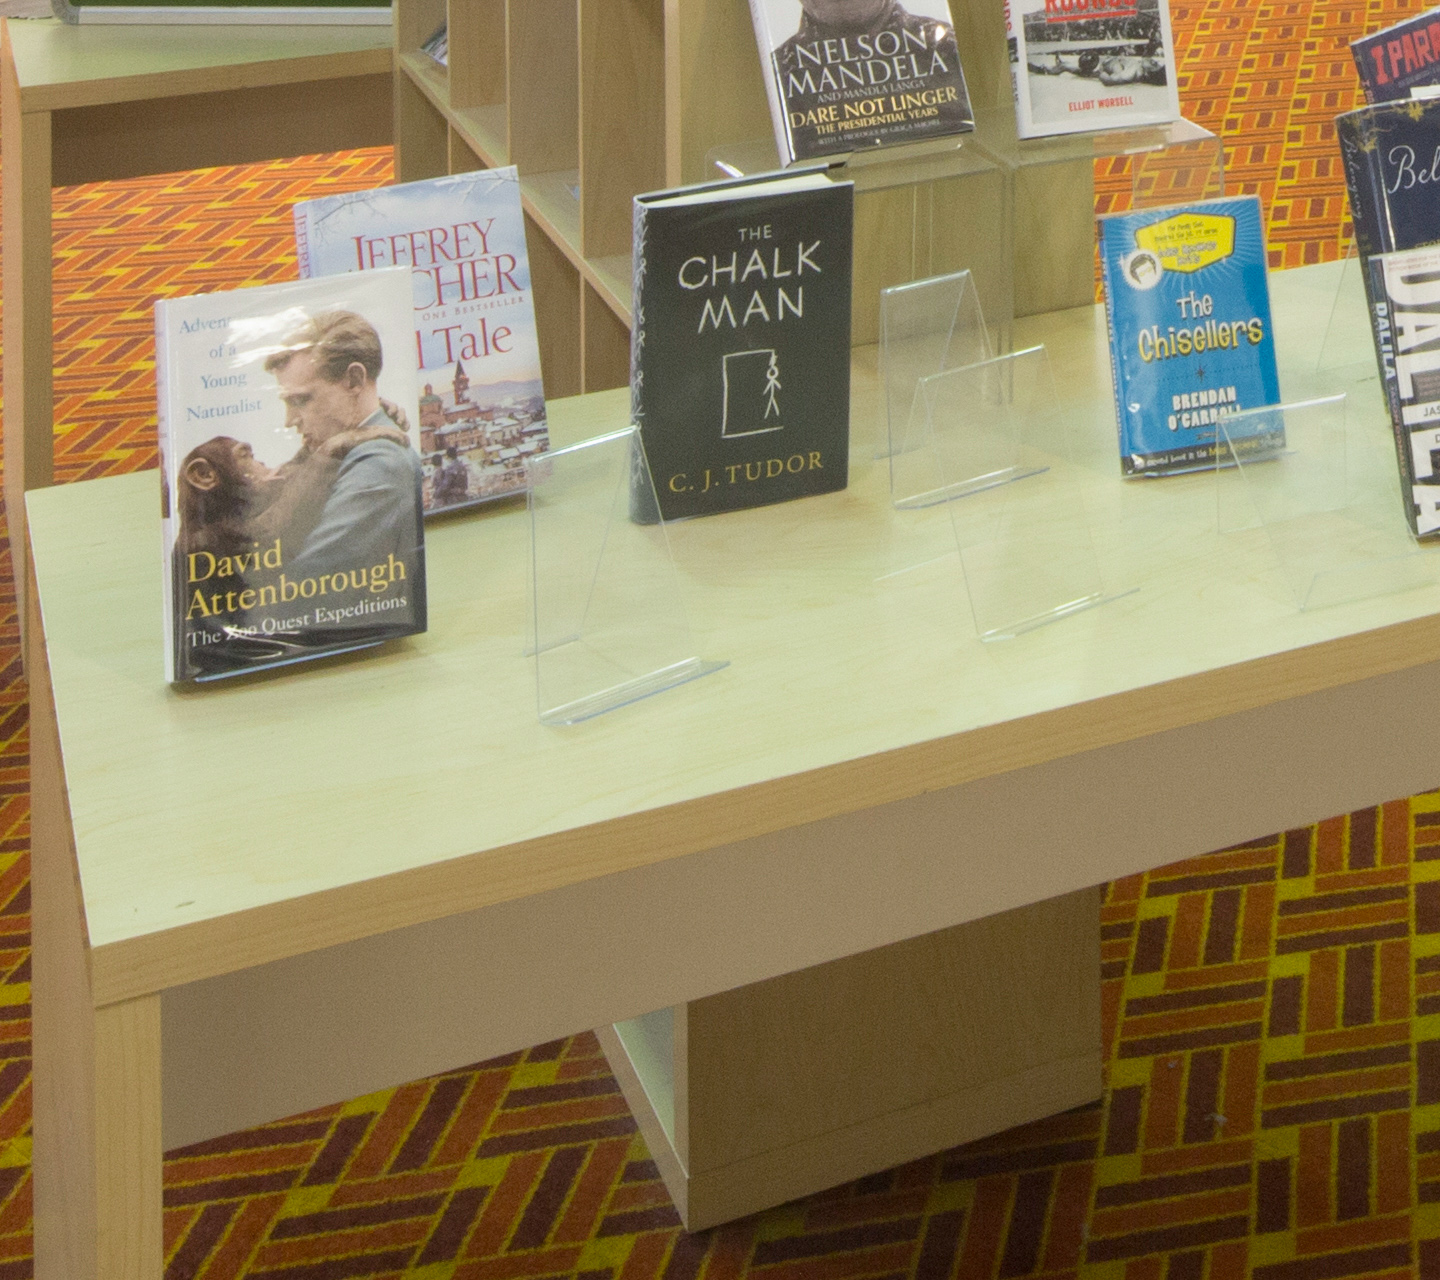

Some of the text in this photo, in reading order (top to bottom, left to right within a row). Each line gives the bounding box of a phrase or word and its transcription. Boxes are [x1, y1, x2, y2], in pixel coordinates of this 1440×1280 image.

[795, 28, 928, 69] NELSON
[1371, 45, 1389, 85] I
[787, 50, 948, 98] MANDELA
[817, 79, 925, 104] AND MANDLA LANGA
[790, 86, 958, 129] DARE NOT LINGER
[816, 124, 836, 135] THE
[838, 112, 906, 131] PRESIDENTIAL
[908, 107, 939, 120] YEARS
[1068, 95, 1134, 112] ELLIOT WORSELL
[351, 217, 496, 271] JEFFREY
[738, 224, 773, 241] THE
[678, 240, 822, 290] CHALK
[698, 286, 803, 333] MAN
[1176, 290, 1213, 319] The
[209, 344, 236, 359] of a
[432, 317, 513, 364] Tale
[1138, 317, 1263, 362] Chisellers
[1375, 302, 1397, 381] DALILA
[201, 373, 247, 389] Young
[1172, 386, 1237, 412] BRENDAN
[186, 398, 262, 421] Naturalist
[669, 450, 824, 493] C. J. TUDOR
[187, 538, 283, 583] David
[185, 553, 406, 620] Attenborough
[186, 629, 222, 648] The
[262, 614, 310, 635] Quest
[314, 595, 408, 624] Expeditions
